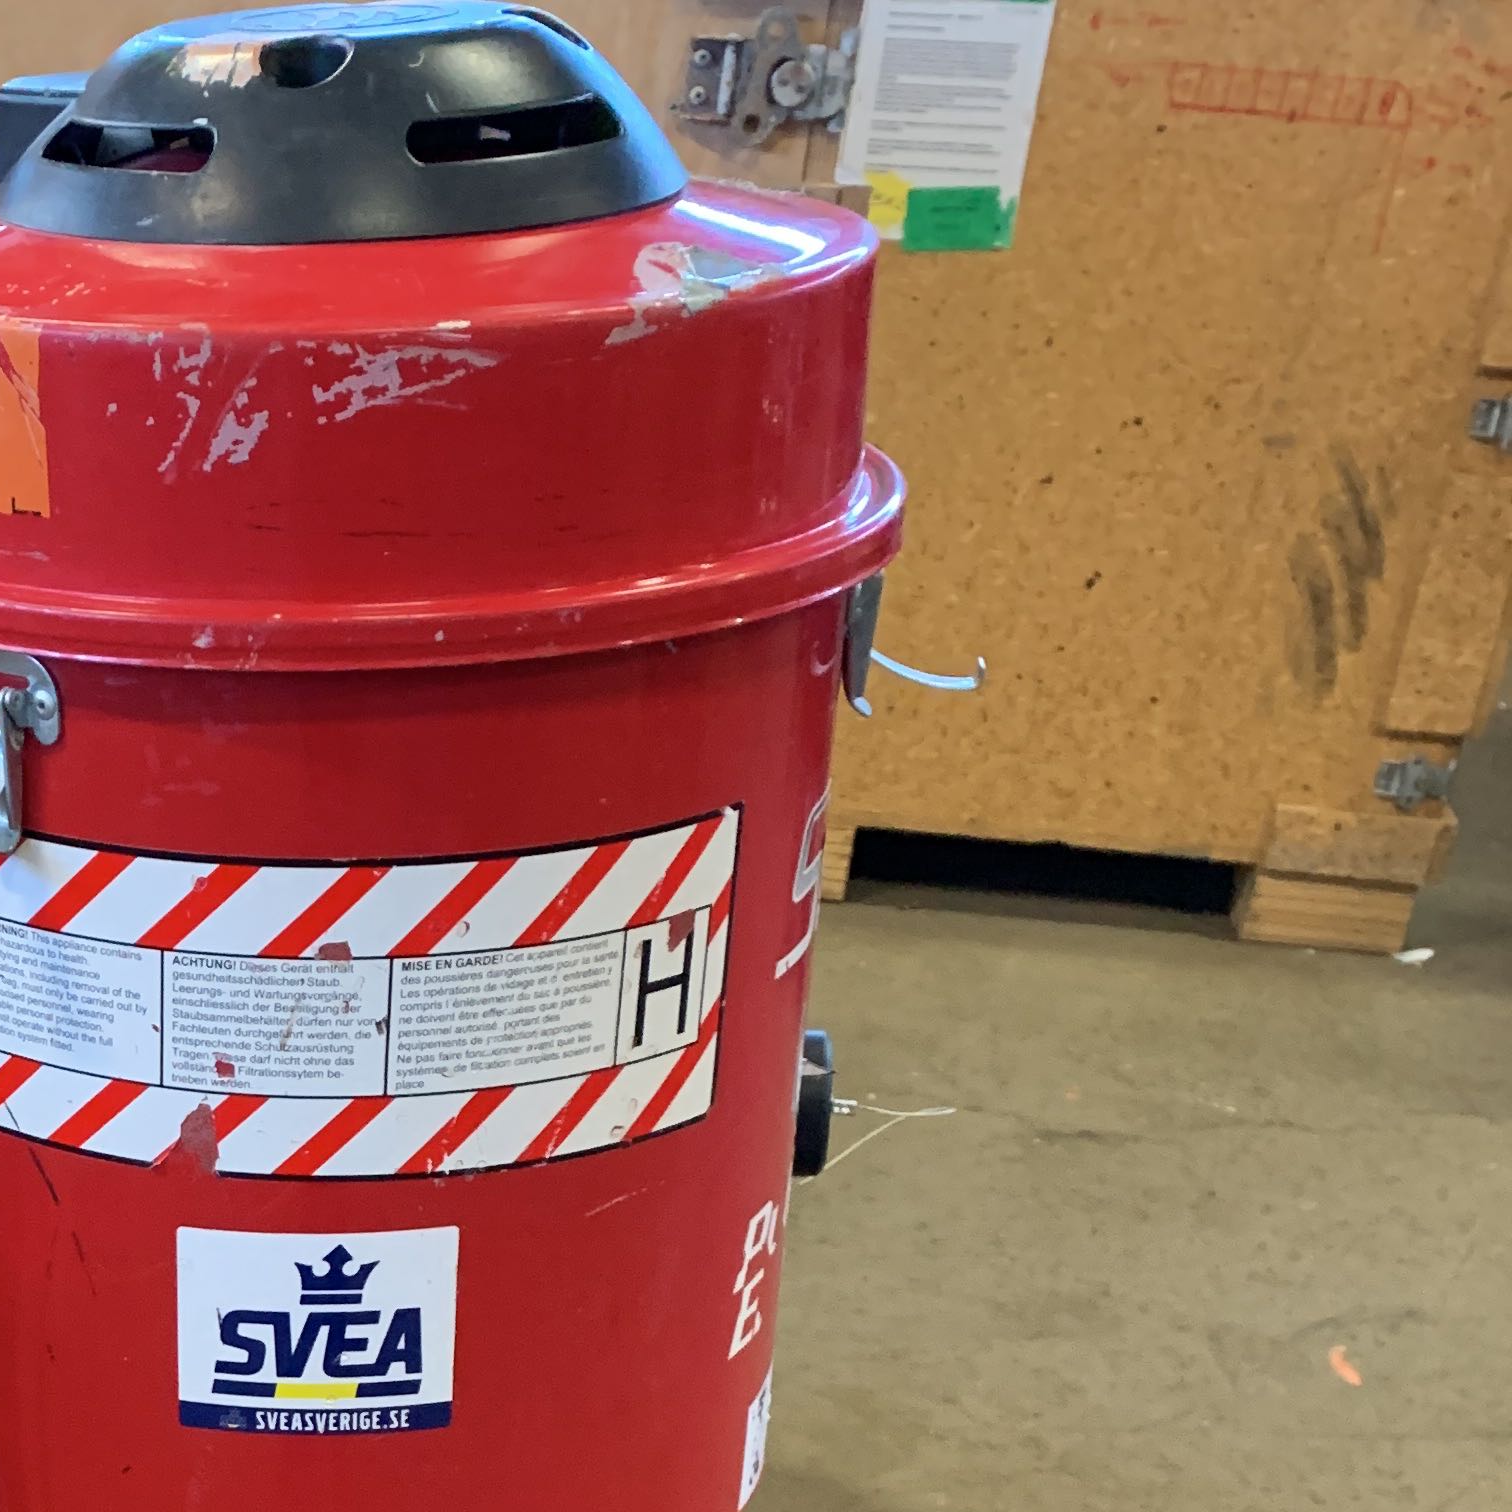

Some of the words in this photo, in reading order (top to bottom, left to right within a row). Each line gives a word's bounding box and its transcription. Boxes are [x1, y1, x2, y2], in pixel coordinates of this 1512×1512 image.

[0, 936, 45, 957] hazardous
[48, 949, 57, 959] to
[31, 930, 51, 945] This
[52, 938, 98, 955] appliance
[100, 945, 143, 961] contains
[21, 956, 38, 968] and
[40, 961, 101, 981] maintenance
[172, 955, 237, 970] ACHTUNG!
[239, 960, 278, 973] Dieses
[280, 962, 314, 974] Gerät
[315, 964, 355, 975] enthält
[400, 973, 421, 986] des
[556, 958, 580, 972] pour
[582, 955, 591, 966] la
[401, 960, 432, 972] MISE
[435, 958, 453, 970] EN
[455, 954, 503, 968] GARDE!
[505, 952, 525, 963] Cet
[29, 971, 70, 990] including
[71, 980, 111, 996] removal
[112, 987, 123, 998] of
[124, 988, 142, 1000] the
[172, 982, 227, 999] Leerungs-
[229, 989, 251, 999] und
[399, 988, 421, 1000] Les
[423, 982, 481, 1001] opérations
[483, 981, 499, 993] de
[537, 975, 548, 986] et
[633, 933, 695, 1049] H
[21, 982, 44, 995] must
[45, 987, 64, 1001] only
[66, 991, 79, 1003] be
[80, 993, 115, 1010] carried
[116, 1001, 133, 1012] out
[134, 1003, 148, 1016] by
[172, 996, 251, 1012] einschliesslich
[252, 1002, 271, 1013] der
[273, 1002, 340, 1016] Beseitigung
[341, 1000, 362, 1015] der
[398, 1015, 413, 1026] ne
[415, 1011, 456, 1025] doivent
[458, 1010, 479, 1022] être
[538, 1001, 558, 1014] que
[560, 998, 577, 1011] par
[578, 994, 593, 1006] du
[399, 1001, 443, 1015] compris
[517, 991, 531, 1003] du
[16, 1006, 54, 1021] personal
[76, 1007, 115, 1025] wearing
[296, 1017, 332, 1028] dürfen
[334, 1018, 356, 1028] nur
[357, 1018, 377, 1028] von
[11, 1017, 45, 1034] operate
[46, 1026, 80, 1043] without
[81, 1032, 97, 1045] the
[98, 1035, 114, 1047] full
[17, 1031, 49, 1046] system
[171, 1021, 232, 1036] Fachleuten
[354, 1030, 372, 1040] die
[397, 1027, 452, 1041] personnel
[503, 1017, 540, 1032] portant
[542, 1014, 561, 1025] des
[171, 1036, 252, 1051] entsprechende
[254, 1041, 355, 1055] Schutzausrüstung
[396, 1054, 413, 1065] Ne
[415, 1053, 436, 1066] pas
[438, 1050, 463, 1062] faire
[526, 1039, 555, 1053] avant
[556, 1036, 576, 1048] que
[577, 1034, 592, 1044] les
[397, 1036, 468, 1052] équipements
[470, 1036, 484, 1047] de
[249, 1053, 271, 1065] darf
[273, 1055, 301, 1067] nicht
[303, 1056, 332, 1067] ohne
[334, 1056, 355, 1067] das
[453, 1063, 468, 1074] de
[592, 1043, 606, 1053] en
[237, 1066, 324, 1081] Filtrationssytem
[394, 1079, 425, 1092] place
[214, 1306, 423, 1379] SVEA
[255, 1408, 411, 1434] SVEASVERIGE.SE
